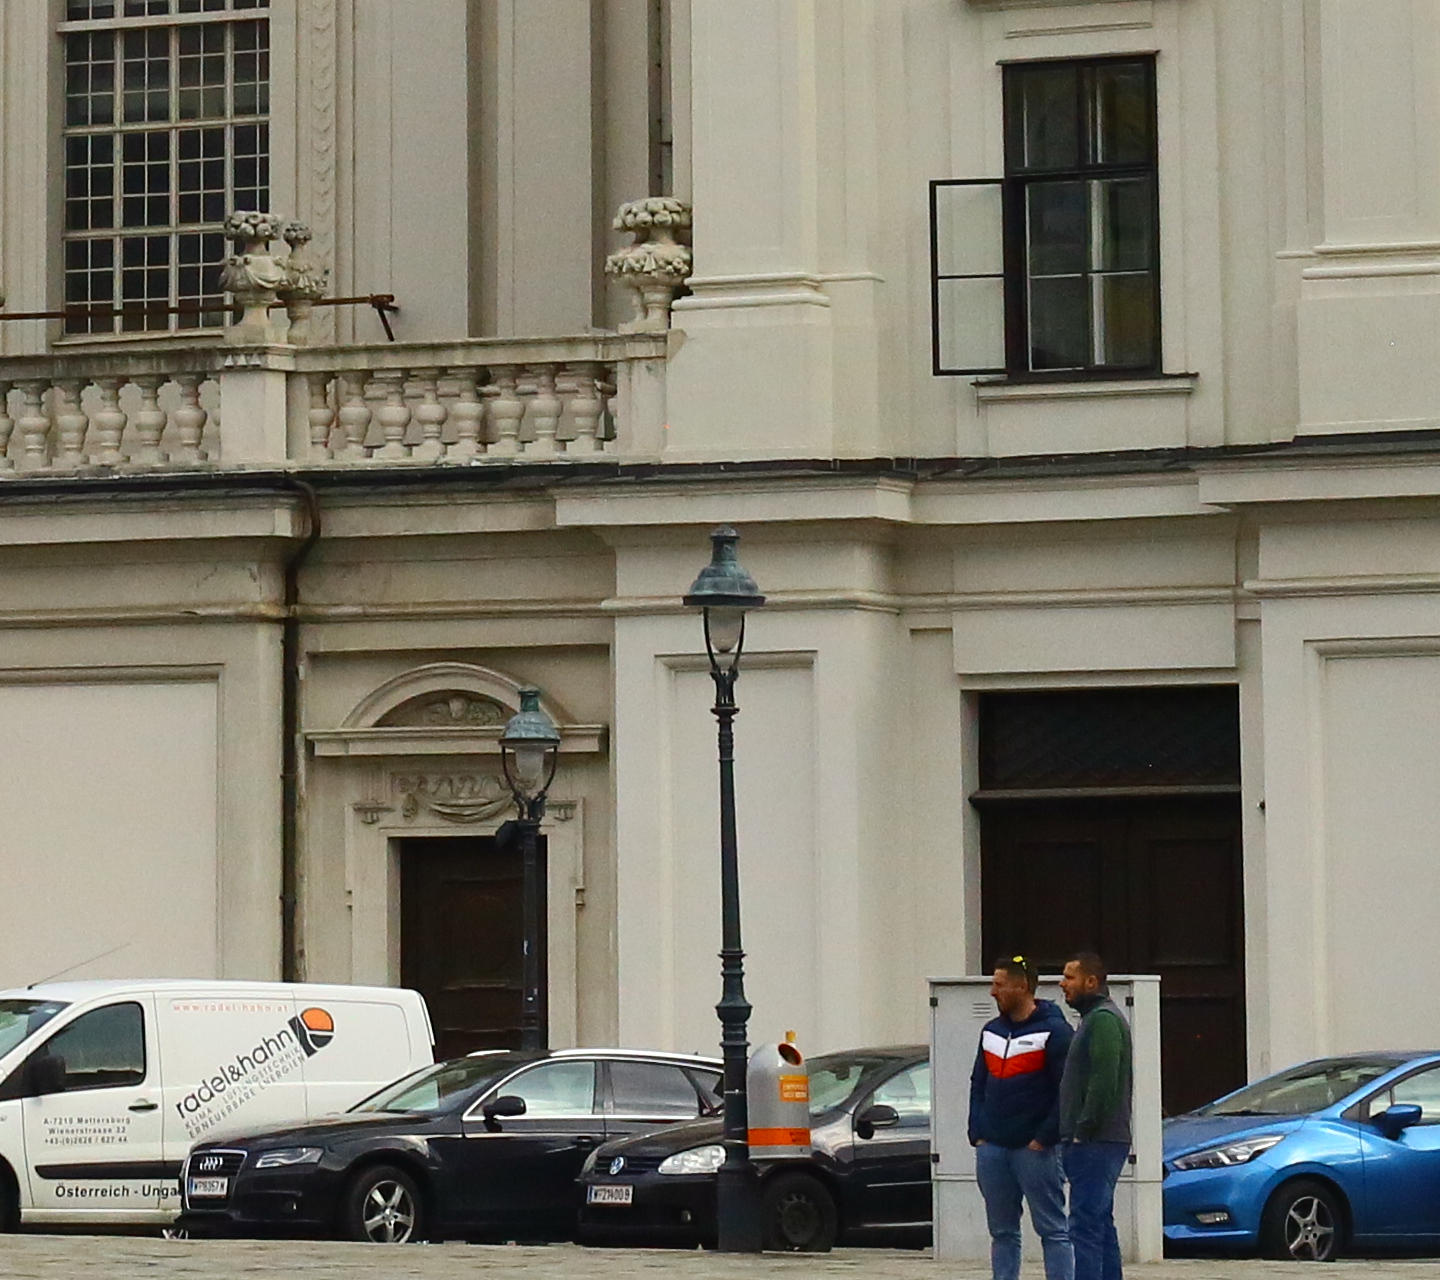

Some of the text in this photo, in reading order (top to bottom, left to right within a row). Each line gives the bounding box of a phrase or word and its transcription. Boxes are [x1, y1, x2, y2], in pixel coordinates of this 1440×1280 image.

[173, 1004, 288, 1013] www.radel-hahn.at
[176, 1029, 294, 1119] radel&hahn
[189, 1053, 306, 1139] ERNEUERBARE ENERGIEN
[77, 1116, 131, 1125] Mattersburg
[185, 1107, 213, 1130] KLIMA
[49, 1127, 113, 1135] Wienerstrasse
[55, 1182, 129, 1198] Österreich
[142, 1184, 180, 1200] Unga
